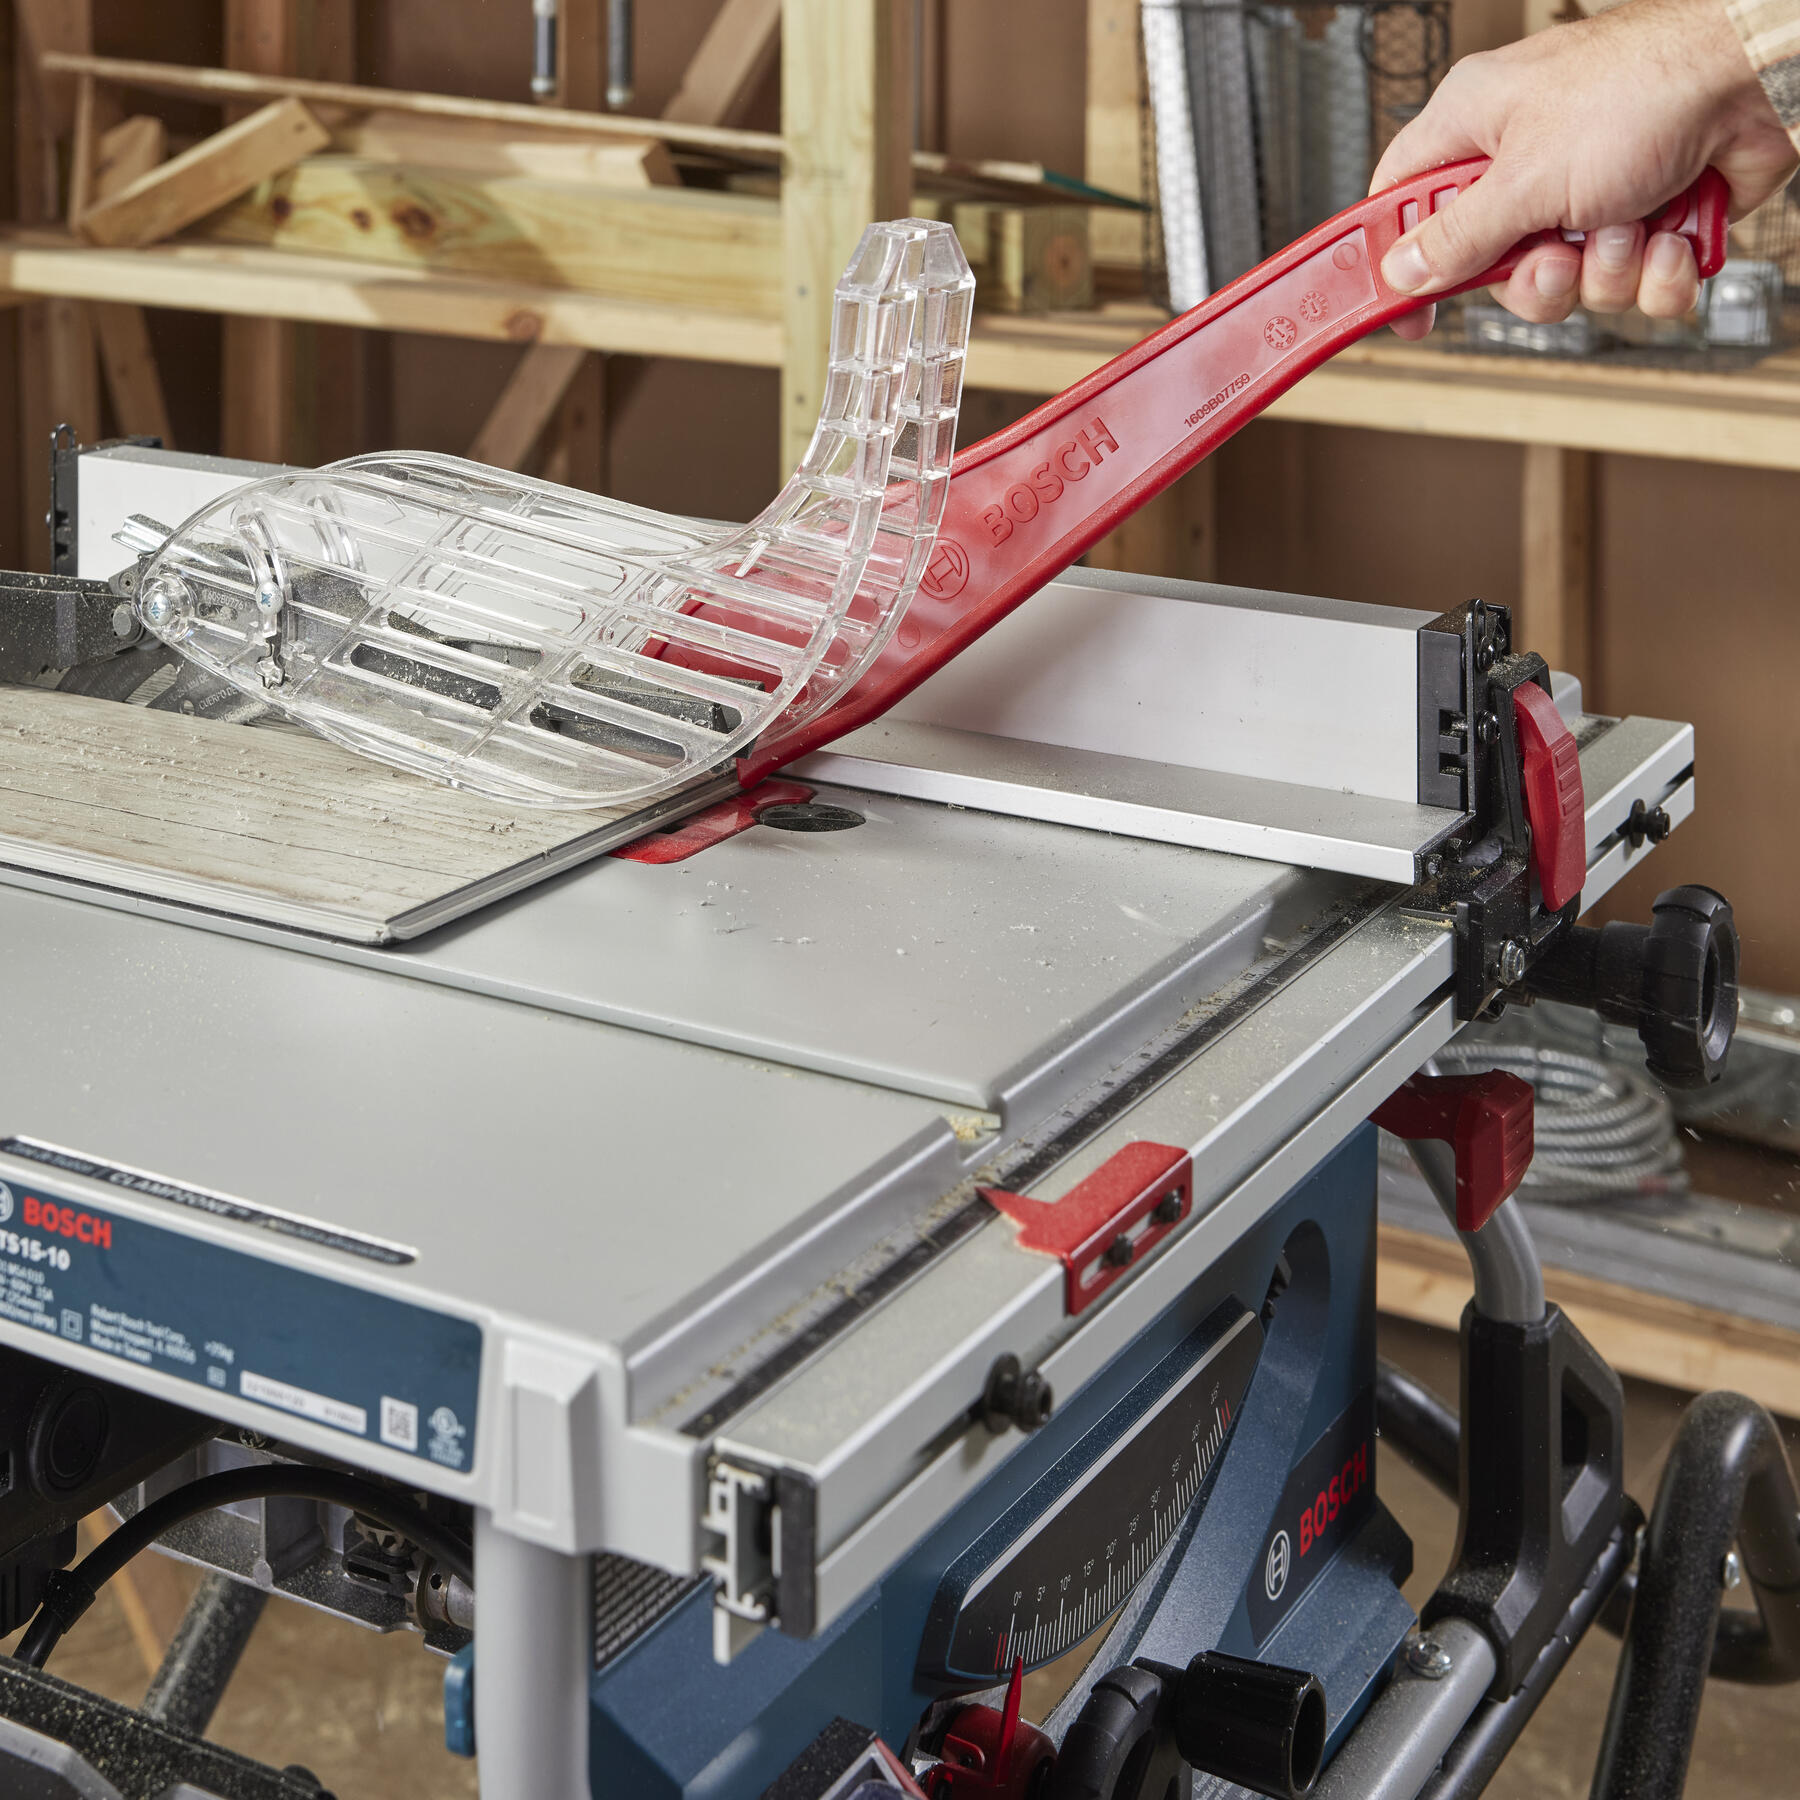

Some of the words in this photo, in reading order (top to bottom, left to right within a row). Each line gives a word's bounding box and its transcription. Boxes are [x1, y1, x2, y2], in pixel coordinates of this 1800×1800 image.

[1184, 373, 1251, 428] 1609B07759
[979, 416, 1120, 548] BOSCH
[23, 1195, 113, 1251] BOSCH
[1298, 1441, 1368, 1559] BOSCH
